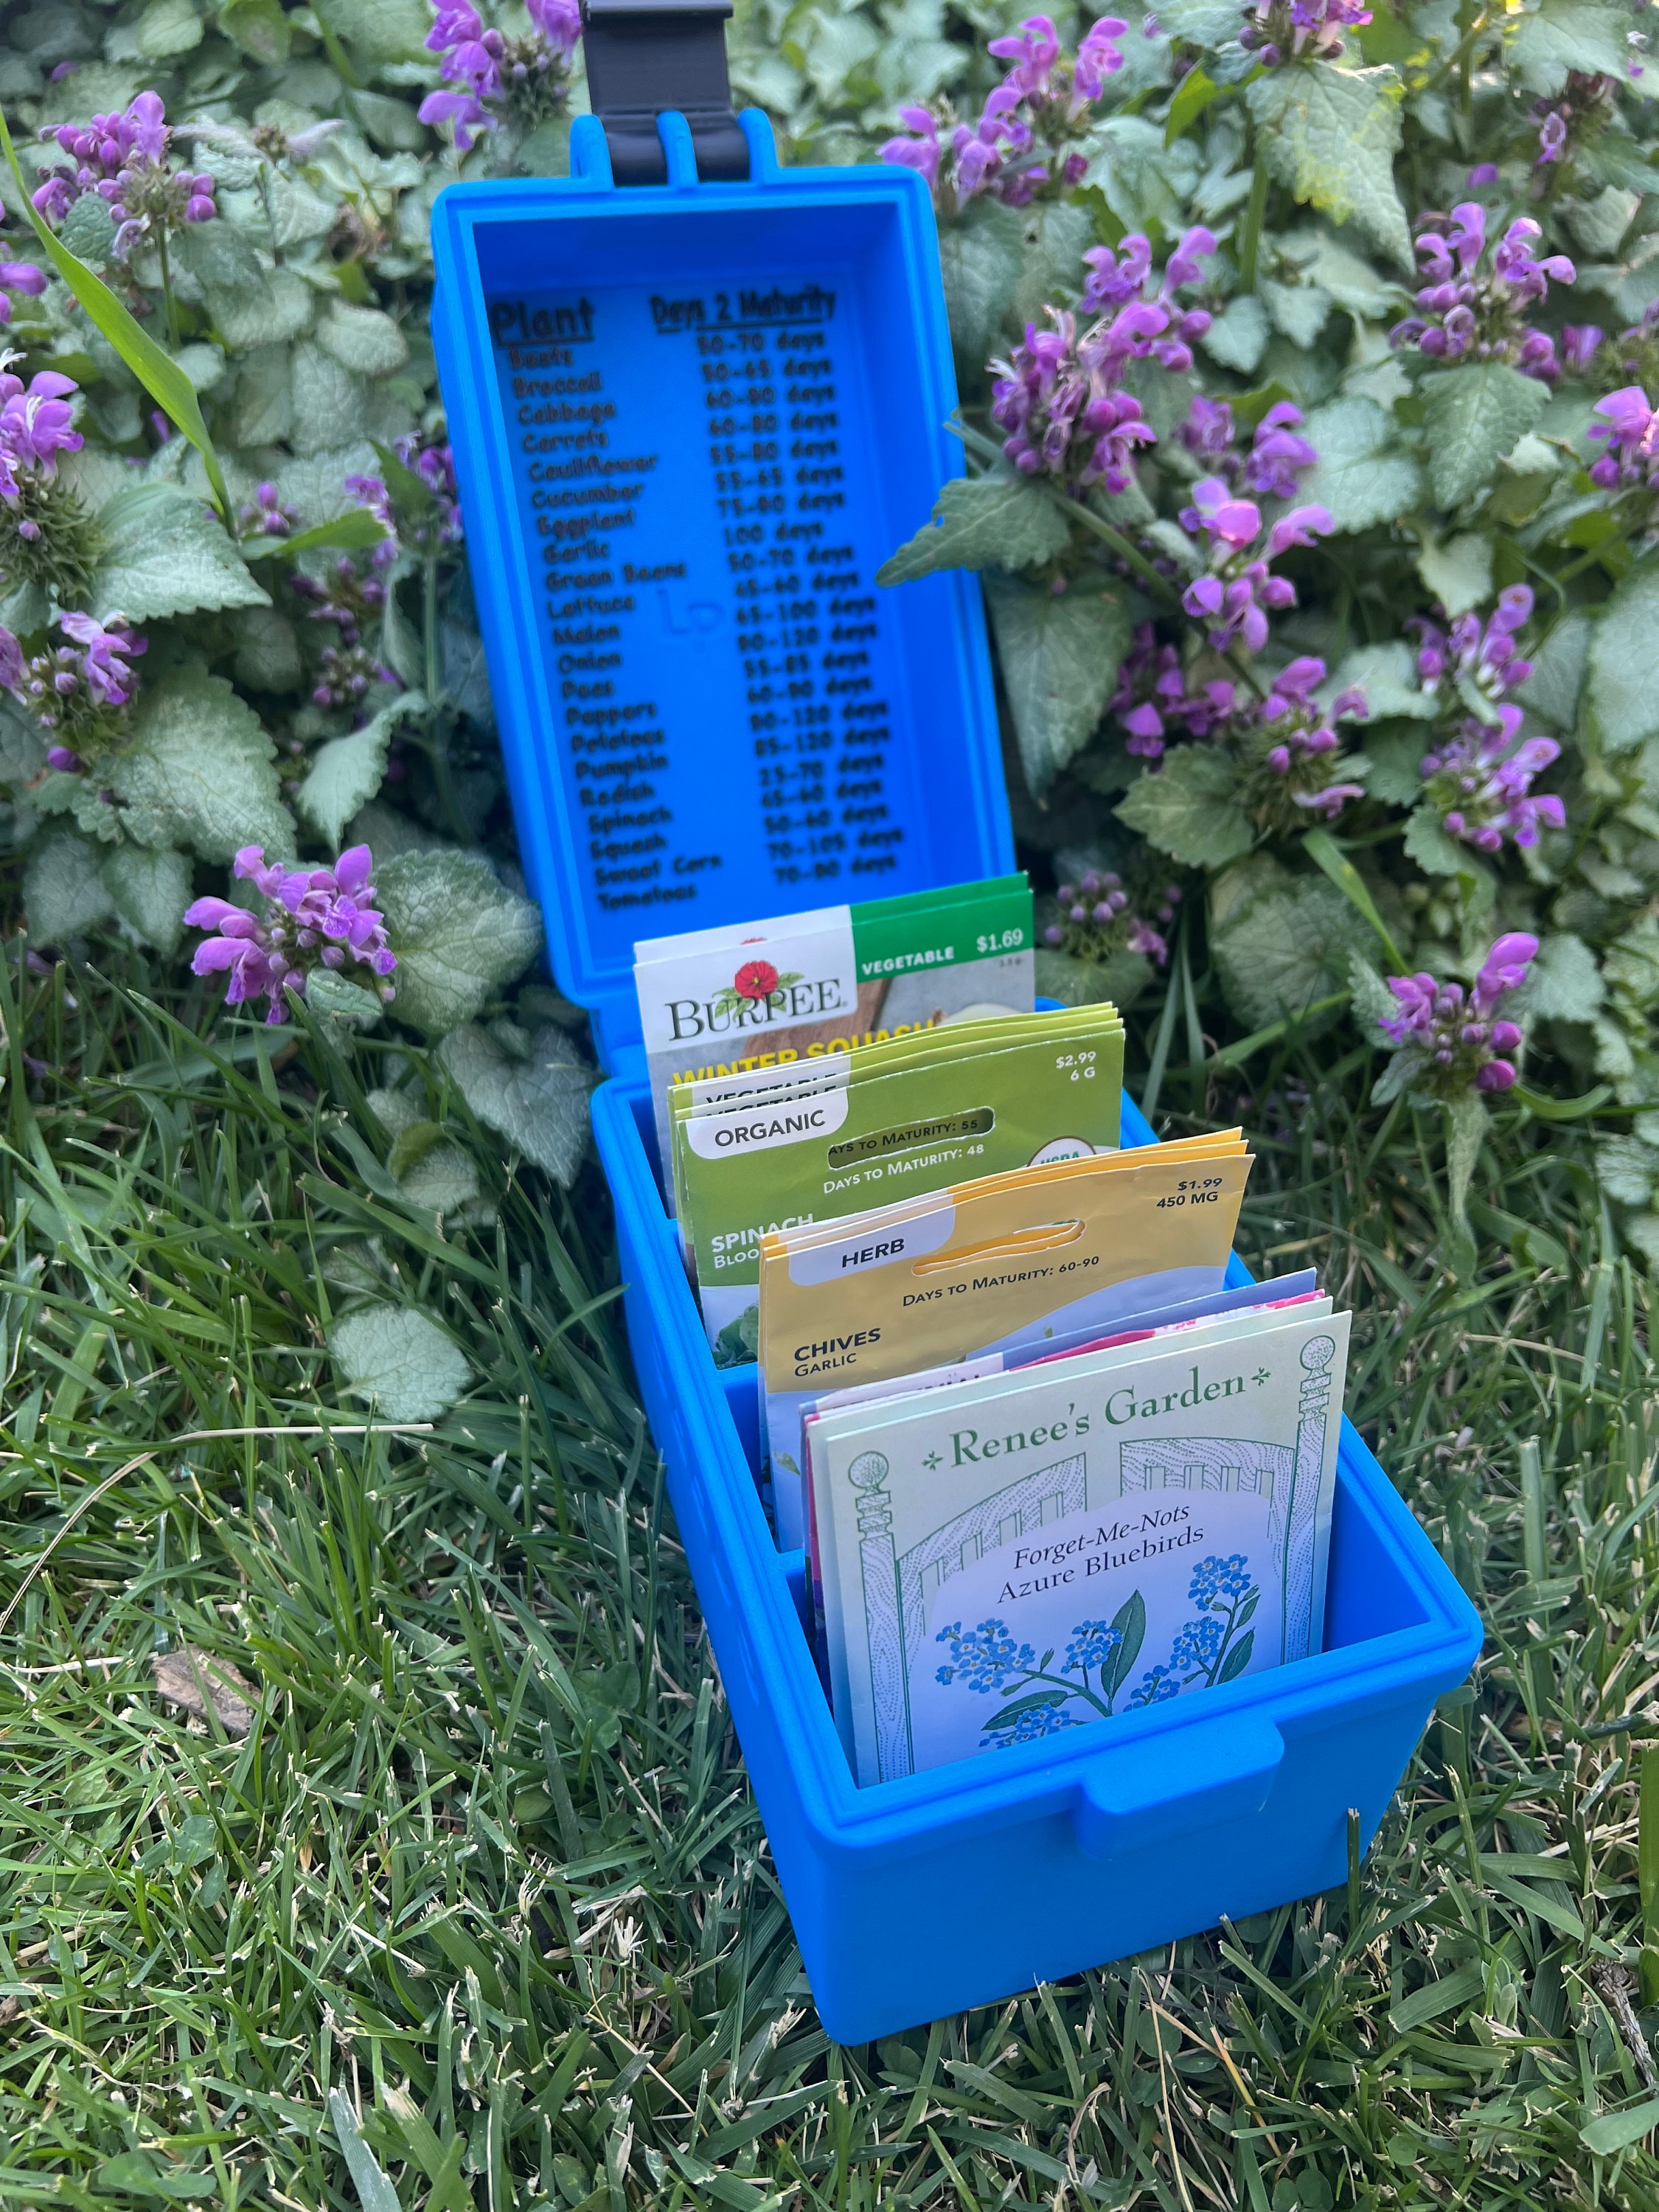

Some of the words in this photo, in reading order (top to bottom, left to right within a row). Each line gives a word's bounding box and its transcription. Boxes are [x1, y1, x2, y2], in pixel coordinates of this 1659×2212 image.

[491, 298, 594, 344] Plant
[650, 295, 704, 330] Days
[715, 291, 731, 322] 2
[740, 283, 835, 321] Maturity
[509, 347, 573, 369] Beets
[776, 331, 824, 352] days
[513, 370, 602, 398] Broccoli
[783, 358, 831, 380] days
[518, 403, 616, 425] Cabbage
[787, 384, 835, 406] days
[522, 429, 608, 454] Carrots
[790, 410, 838, 434] days
[529, 454, 657, 481] Cauliflower
[790, 439, 838, 462] days
[532, 484, 643, 507] Cucumber
[796, 465, 844, 488] days
[538, 508, 635, 540] Eggplant
[797, 492, 845, 515] days
[543, 538, 609, 563] Garlic
[724, 524, 762, 547] 100
[776, 521, 824, 543] days
[546, 571, 613, 592] Green
[623, 563, 686, 582] Beans
[807, 546, 854, 566] days
[548, 597, 634, 620] Lettuce
[813, 571, 859, 593] days
[554, 625, 621, 644] Melon
[829, 597, 875, 619] days
[558, 650, 622, 674] Onion
[831, 623, 877, 644] days
[563, 680, 614, 698] Peas
[823, 652, 869, 673] days
[566, 703, 658, 729] Peppers
[826, 676, 872, 698] days
[571, 729, 666, 752] Potatoes
[842, 701, 888, 723] days
[575, 752, 669, 787] Pumpkin
[844, 727, 890, 748] days
[838, 754, 884, 774] days
[588, 806, 672, 836] Spinach
[836, 779, 881, 801] days
[590, 831, 668, 862] Squash
[842, 804, 888, 826] days
[595, 859, 661, 886] Sweet
[673, 855, 723, 874] Corn
[858, 828, 903, 850] days
[598, 886, 698, 911] Tomatoes
[851, 855, 897, 877] days
[862, 947, 954, 975] VEGETABLE
[977, 928, 1023, 953] $1.69
[664, 978, 842, 1041] BURPEE
[1056, 1051, 1096, 1069] $2.99
[1071, 1070, 1079, 1081] 6
[1085, 1067, 1096, 1078] G
[714, 1109, 826, 1147] ORGANIC
[858, 1138, 877, 1151] TO
[882, 1123, 958, 1147] MATURITY:
[961, 1119, 978, 1130] 55
[823, 1175, 861, 1194] DAYS
[864, 1168, 883, 1181] TO
[887, 1147, 963, 1176] MATURITY:
[967, 1144, 984, 1156] 48
[1178, 1178, 1223, 1192] $1.99
[1157, 1194, 1186, 1209] 450
[1190, 1191, 1220, 1204] MG
[711, 1213, 814, 1253] SPINACH
[841, 1238, 905, 1268] HERB
[902, 1287, 943, 1307] DAYS
[947, 1284, 967, 1295] TO
[972, 1267, 1054, 1291] MATURITY:
[1058, 1256, 1099, 1273] 60-90
[793, 1328, 882, 1362] CHIVES
[794, 1352, 858, 1378] GARLIC
[948, 1403, 1091, 1469] Renee's
[1104, 1366, 1245, 1426] Garden
[1013, 1506, 1191, 1571] Forget-Me-Nots
[997, 1569, 1075, 1604] Azure
[1084, 1526, 1204, 1577] Bluebirds
